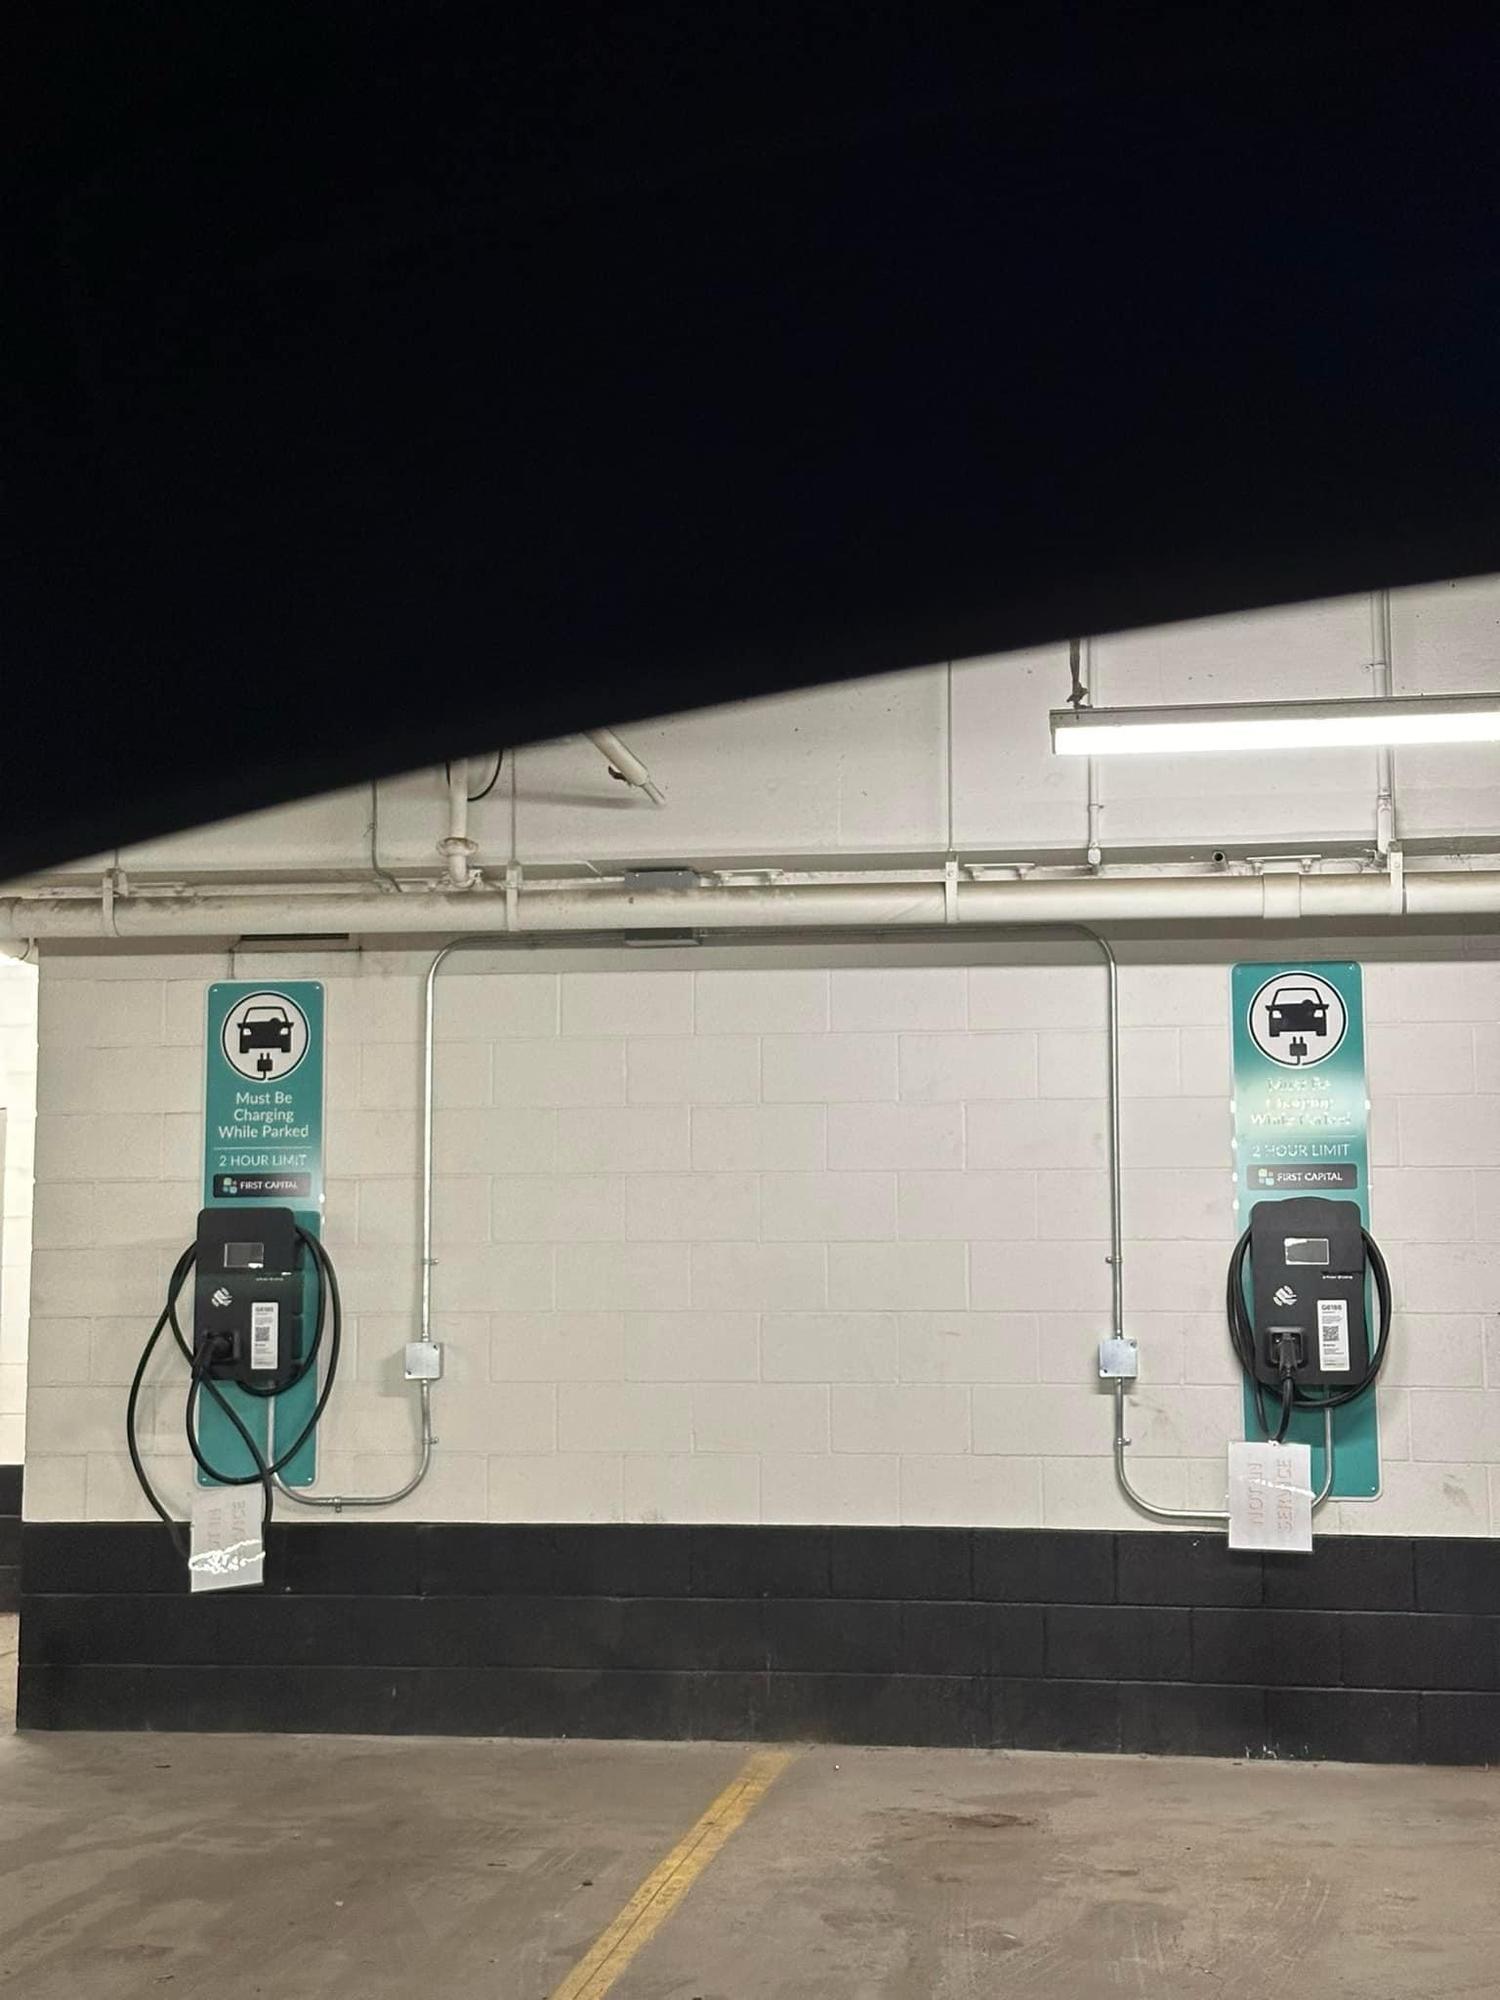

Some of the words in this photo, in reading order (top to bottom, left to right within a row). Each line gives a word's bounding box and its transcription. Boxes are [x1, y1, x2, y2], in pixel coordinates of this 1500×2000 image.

[236, 1092, 271, 1105] Must
[274, 1091, 293, 1104] Be
[234, 1108, 294, 1124] Charging
[218, 1125, 258, 1138] While
[262, 1124, 309, 1138] Parked
[1252, 1145, 1261, 1157] 2
[1264, 1144, 1308, 1157] HOUR
[1311, 1143, 1350, 1156] LIMIT
[219, 1155, 227, 1167] 2
[230, 1154, 269, 1166] HOUR
[272, 1153, 307, 1166] LIMIT
[1276, 1172, 1302, 1182] FIRST
[1304, 1171, 1343, 1181] CAPITAL
[240, 1181, 263, 1190] FIRST
[264, 1180, 298, 1189] CAPITAL
